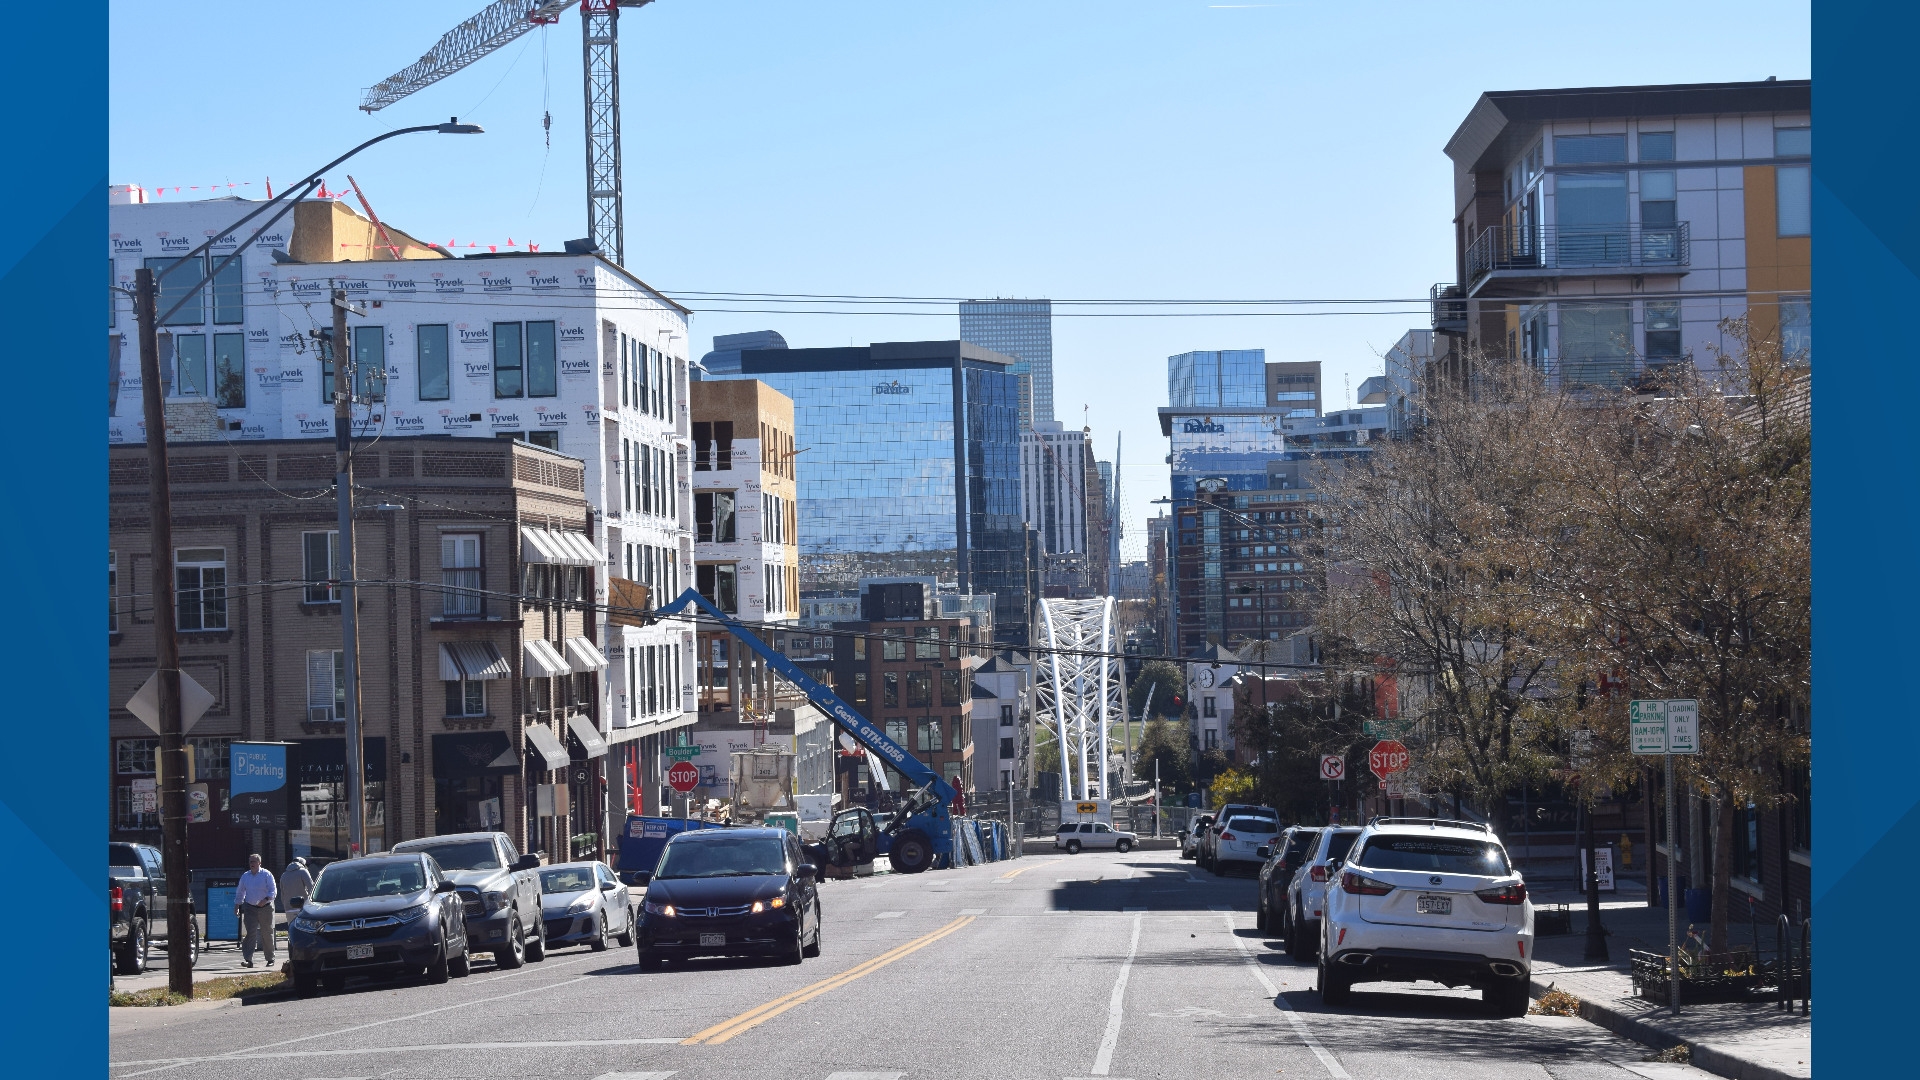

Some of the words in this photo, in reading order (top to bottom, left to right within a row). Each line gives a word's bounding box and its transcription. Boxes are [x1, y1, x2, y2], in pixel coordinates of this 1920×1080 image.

[112, 238, 142, 249] Tyvek
[159, 236, 189, 247] Tyvek
[262, 277, 278, 287] Tyv
[338, 280, 369, 290] Tyvek
[387, 279, 416, 289] Tyvek
[434, 277, 464, 289] Tyvek
[482, 276, 512, 287] Tyvek
[529, 275, 559, 286] Tyvek
[577, 275, 596, 285] Tyv
[120, 282, 137, 291] Tyv
[292, 281, 321, 291] Tyvek
[459, 328, 489, 339] Tyvek
[560, 326, 584, 337] yvek
[561, 359, 590, 370] Tyvek
[876, 382, 910, 395] DaVita
[394, 415, 424, 426] Tyvek
[442, 414, 471, 426] Tyvek
[489, 412, 519, 424] Tyvek
[537, 411, 567, 423] Tyvek
[298, 418, 328, 429] Tyvek
[1183, 418, 1225, 434] DaVita
[241, 425, 265, 434] yvek
[1632, 705, 1639, 720] 2
[1646, 703, 1657, 711] HR
[1668, 704, 1695, 713] LOADING
[1640, 712, 1664, 721] PARKING
[834, 705, 859, 728] Genie
[860, 726, 905, 763] GTH-1056
[1635, 726, 1665, 736] 8AM-10PM
[1676, 726, 1687, 734] ALL
[1673, 735, 1692, 743] TIMES
[727, 742, 748, 750] Tyvek
[249, 753, 267, 761] PUBLIC
[668, 748, 693, 756] Boulder
[1372, 752, 1408, 769] STOP
[249, 763, 284, 779] Parking
[671, 771, 697, 783] STOP
